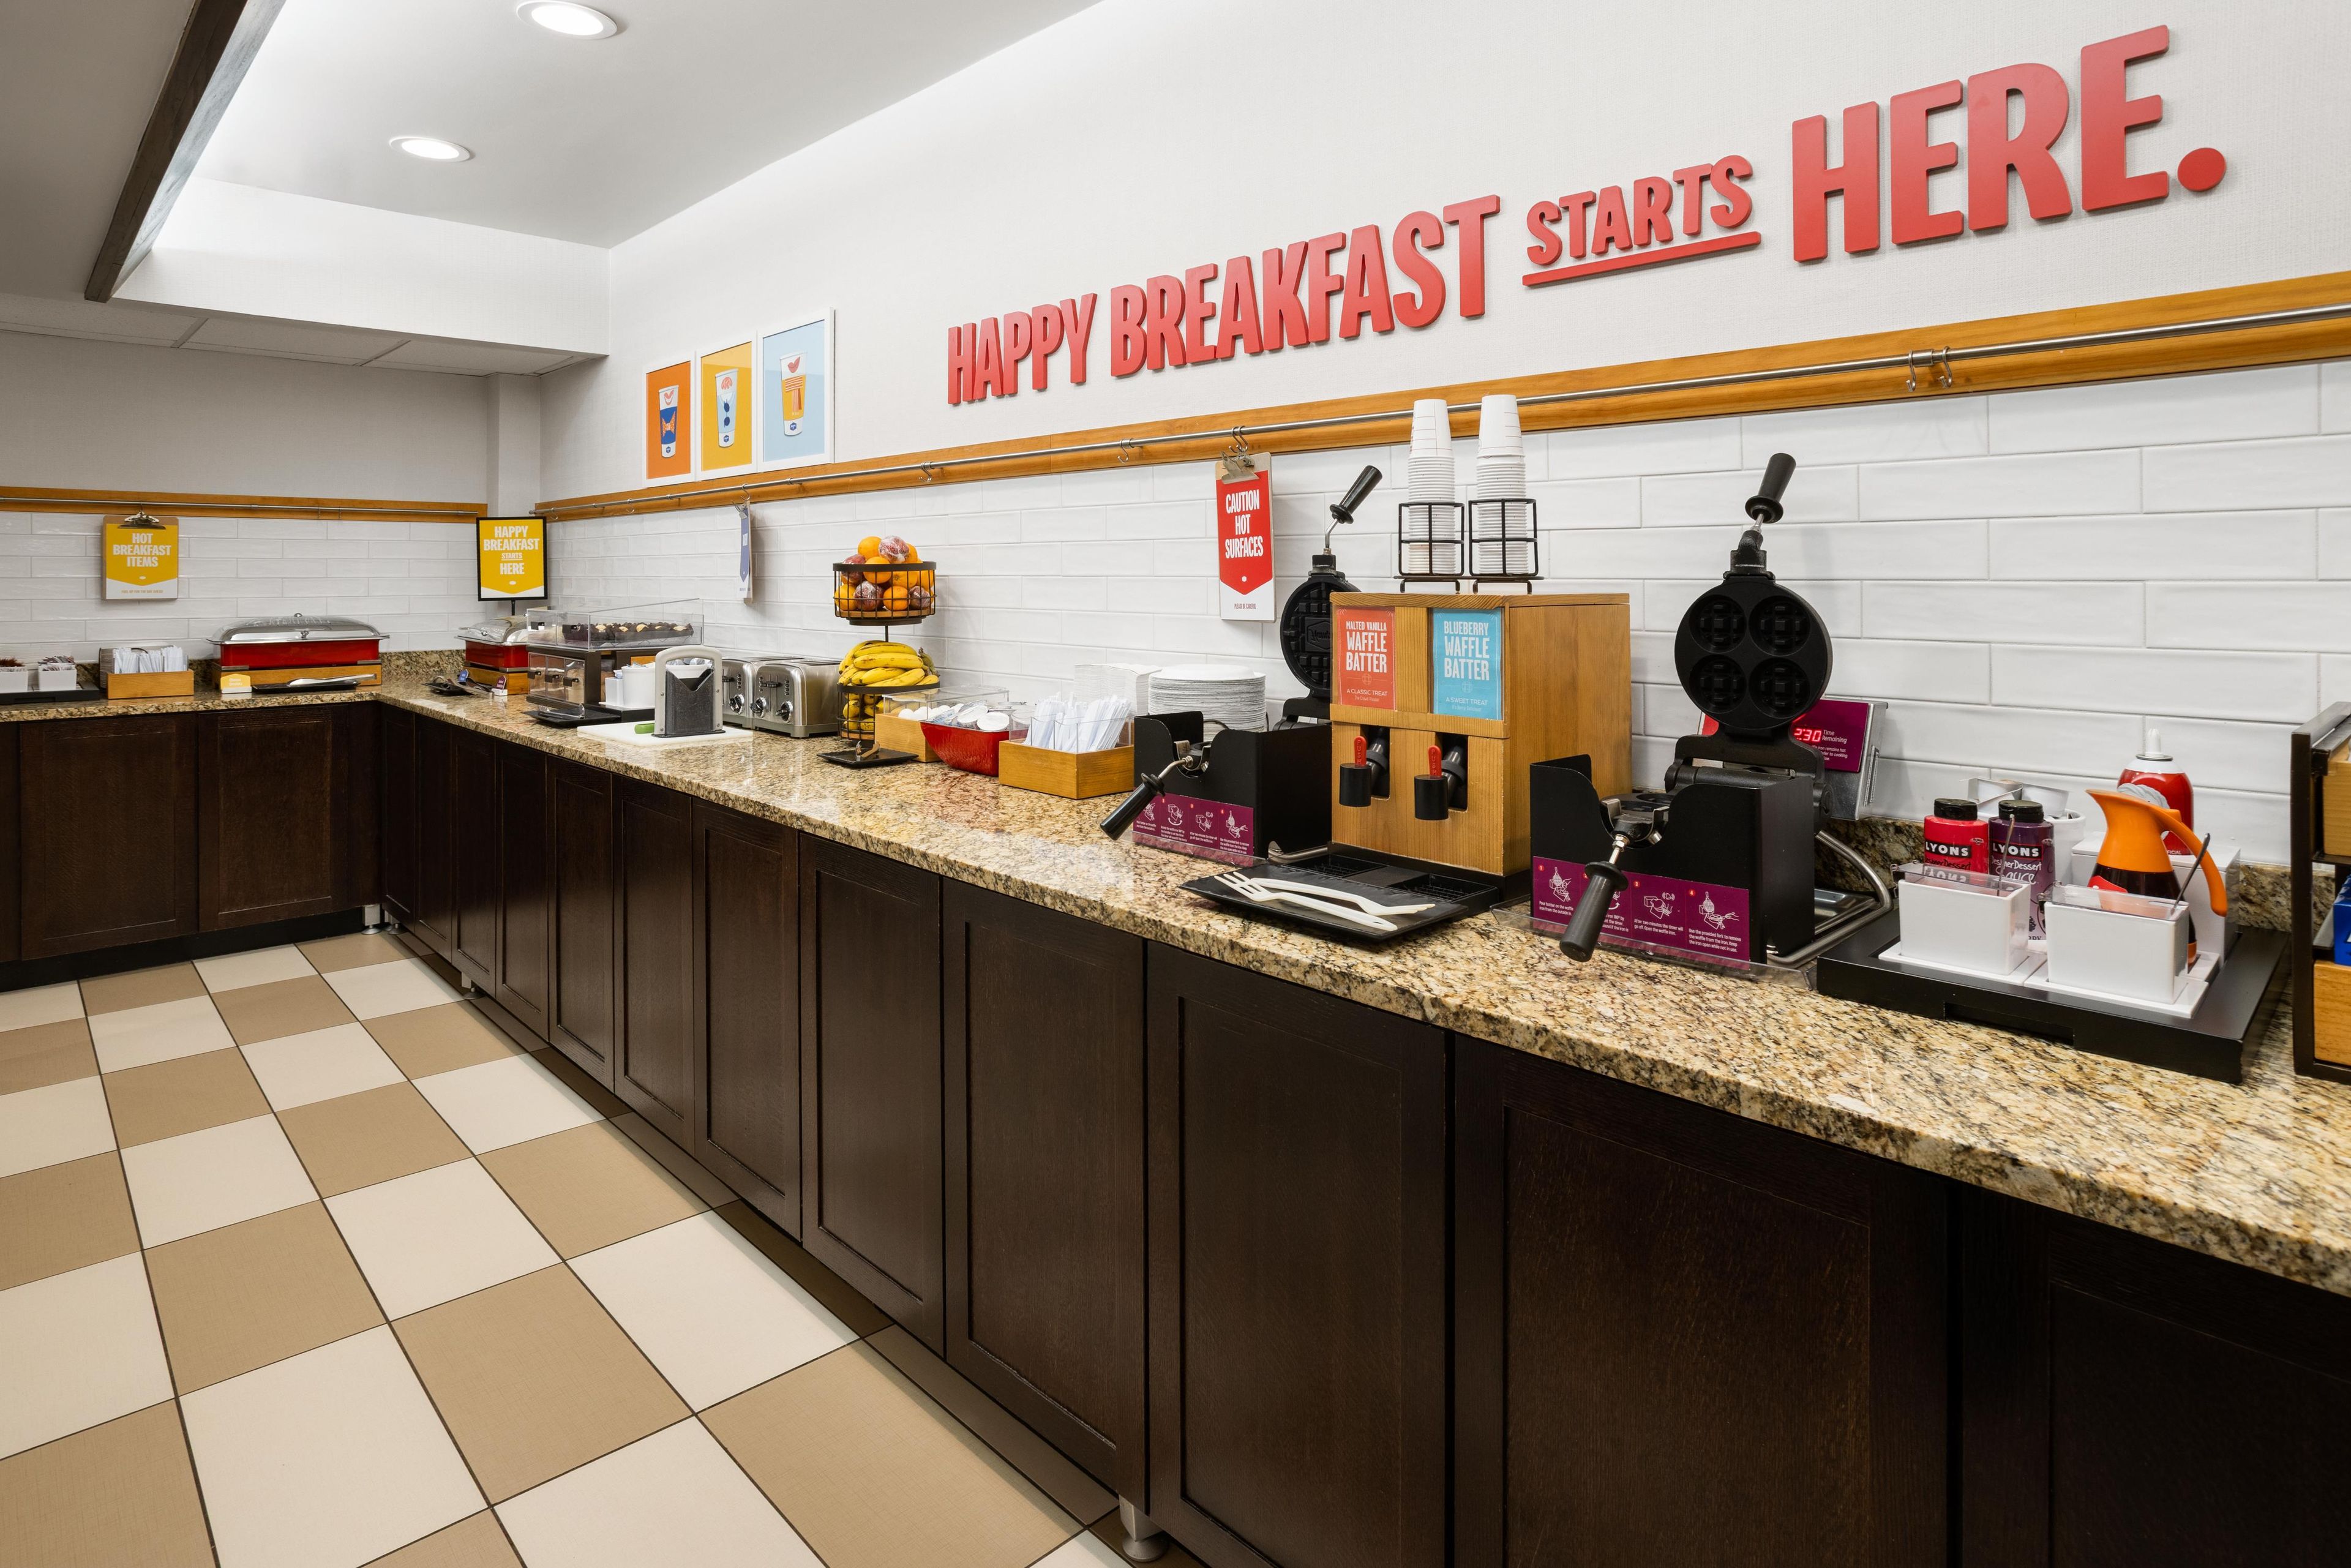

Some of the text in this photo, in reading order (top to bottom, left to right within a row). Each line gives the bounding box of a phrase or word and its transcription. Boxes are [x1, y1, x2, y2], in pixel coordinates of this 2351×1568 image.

[948, 24, 2227, 405] HAPPY BREAKFAST STARTS HERE.
[1226, 489, 1260, 514] CAUTION
[494, 525, 528, 538] HAPPY
[1235, 514, 1250, 535] HOT
[132, 533, 153, 544] HOT
[483, 538, 539, 551] BREAKFAST
[113, 544, 171, 555] BREAKFAST
[1225, 536, 1264, 559] SURFACES
[127, 556, 159, 567] ITEMS
[500, 563, 525, 574] HERE
[1346, 621, 1387, 631] MALTED VANILLA
[1444, 621, 1489, 636] BLUEBERRY
[1346, 631, 1387, 652] WAFFLE
[1444, 636, 1490, 658] WAFFLE
[1346, 651, 1387, 673] BATTER
[1444, 658, 1490, 680] BATTER
[1794, 729, 1821, 742] 2:30
[1822, 735, 1847, 744] Remaining
[1925, 841, 1968, 857] LYONS
[1993, 842, 2039, 857] LYONS
